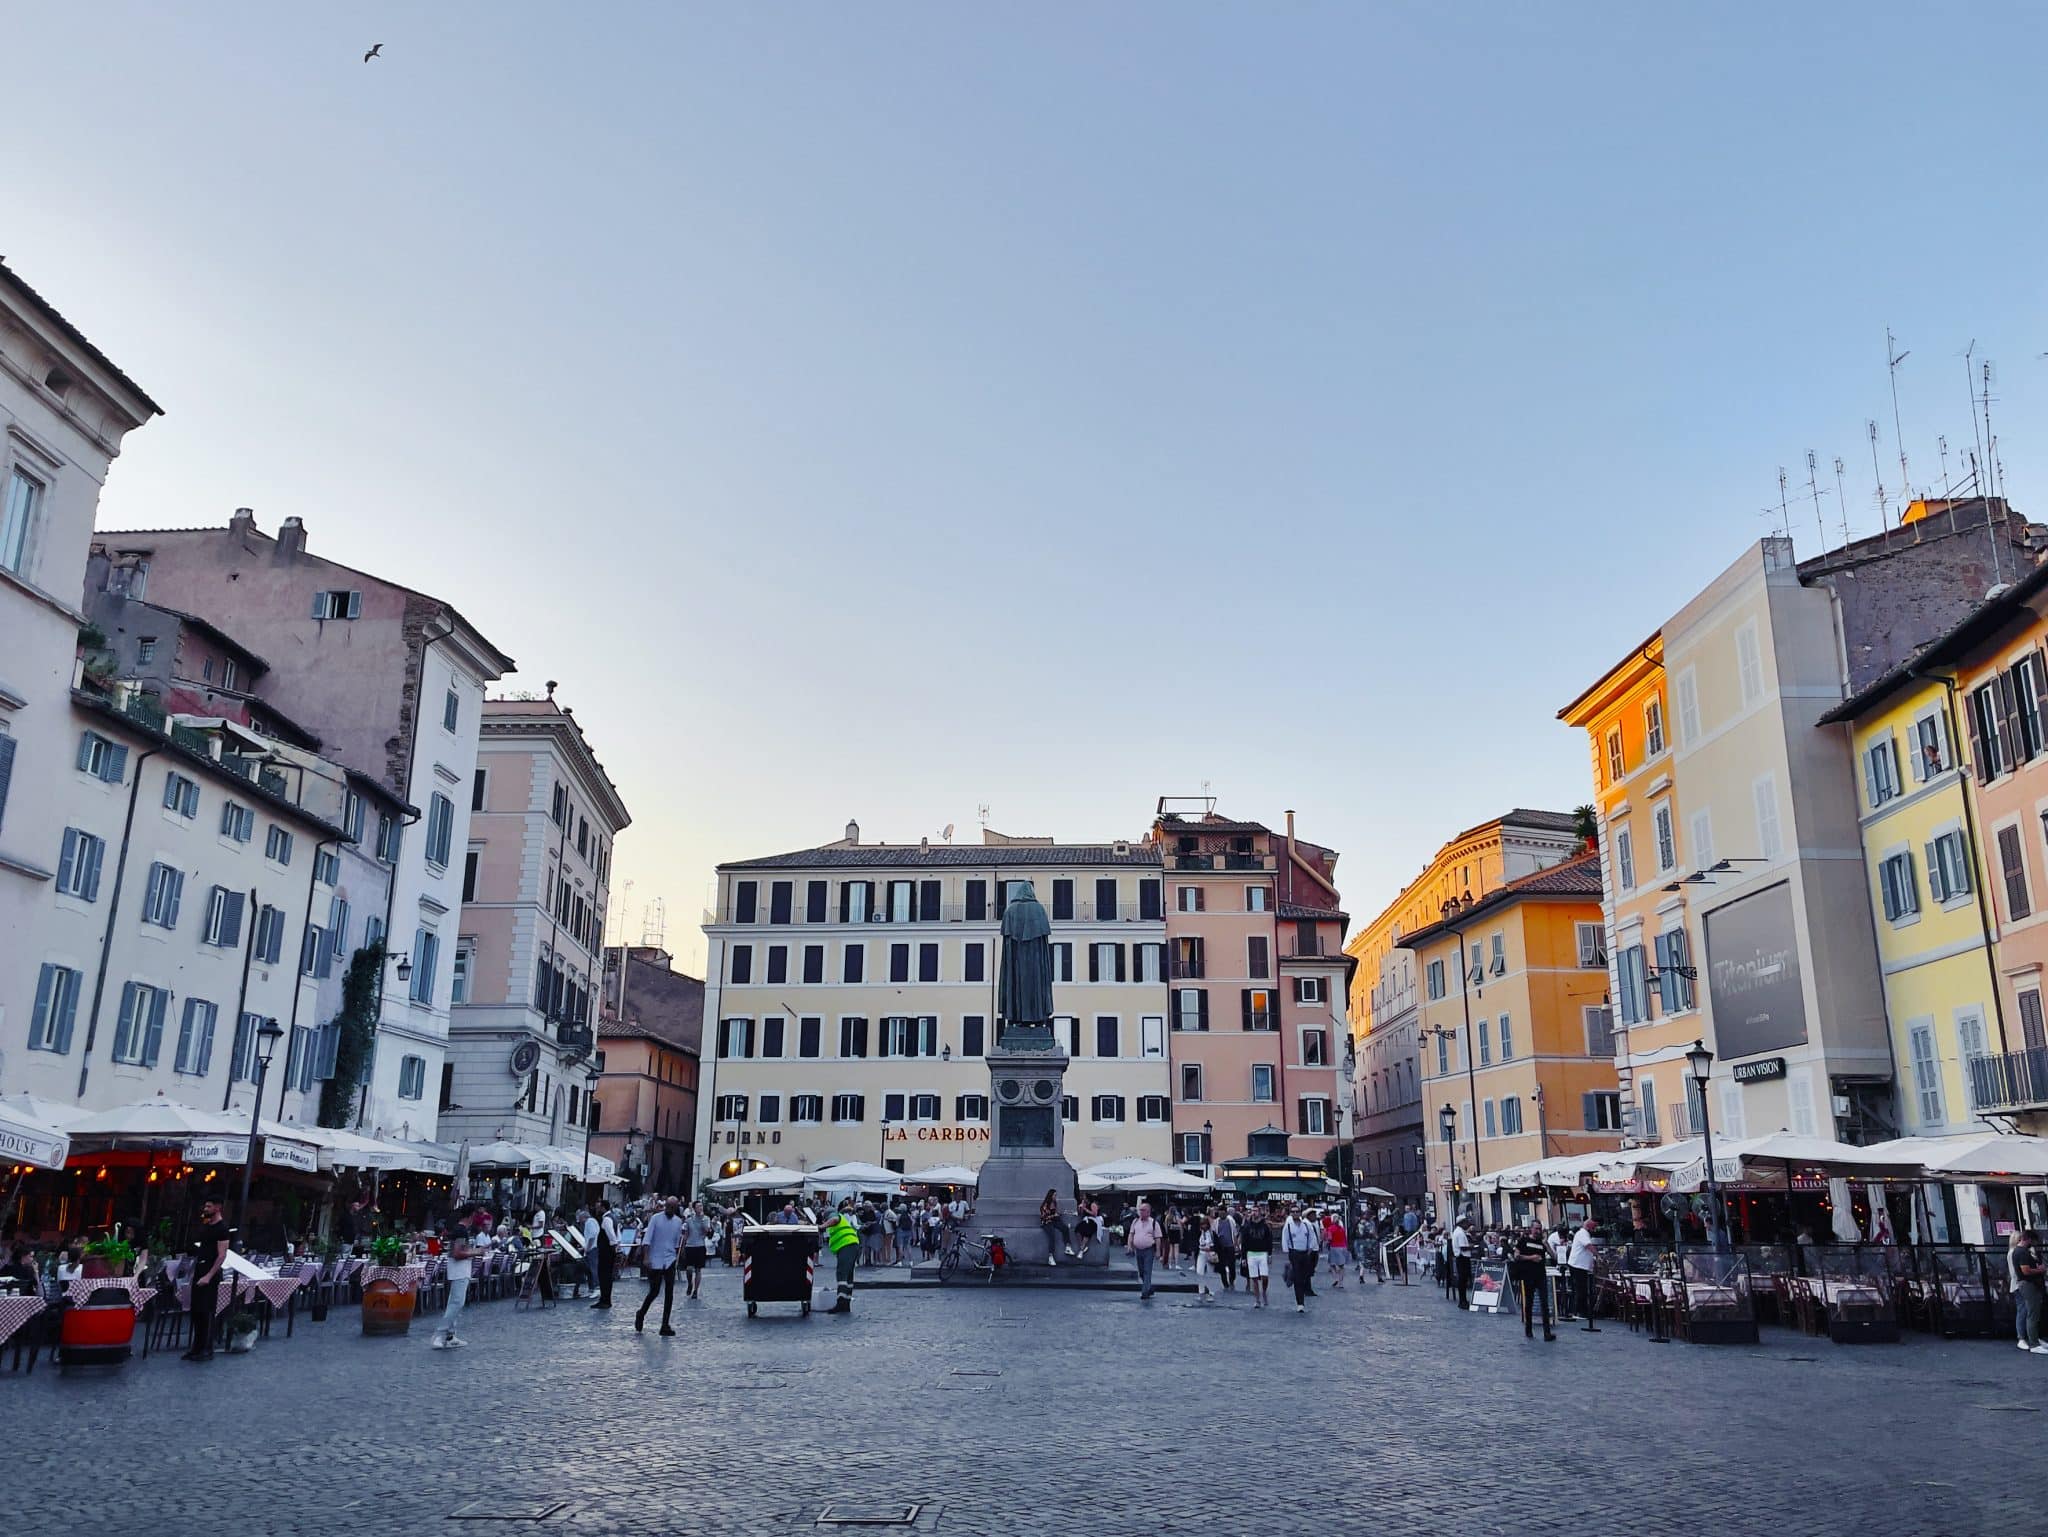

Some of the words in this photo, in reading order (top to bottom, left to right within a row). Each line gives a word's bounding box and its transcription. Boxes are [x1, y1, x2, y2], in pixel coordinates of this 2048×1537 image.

[1734, 1068, 1755, 1079] URBAN
[1756, 1061, 1778, 1075] VISION
[712, 1131, 781, 1144] FORNO
[885, 1128, 907, 1141] LA
[0, 1133, 36, 1155] HOUSE
